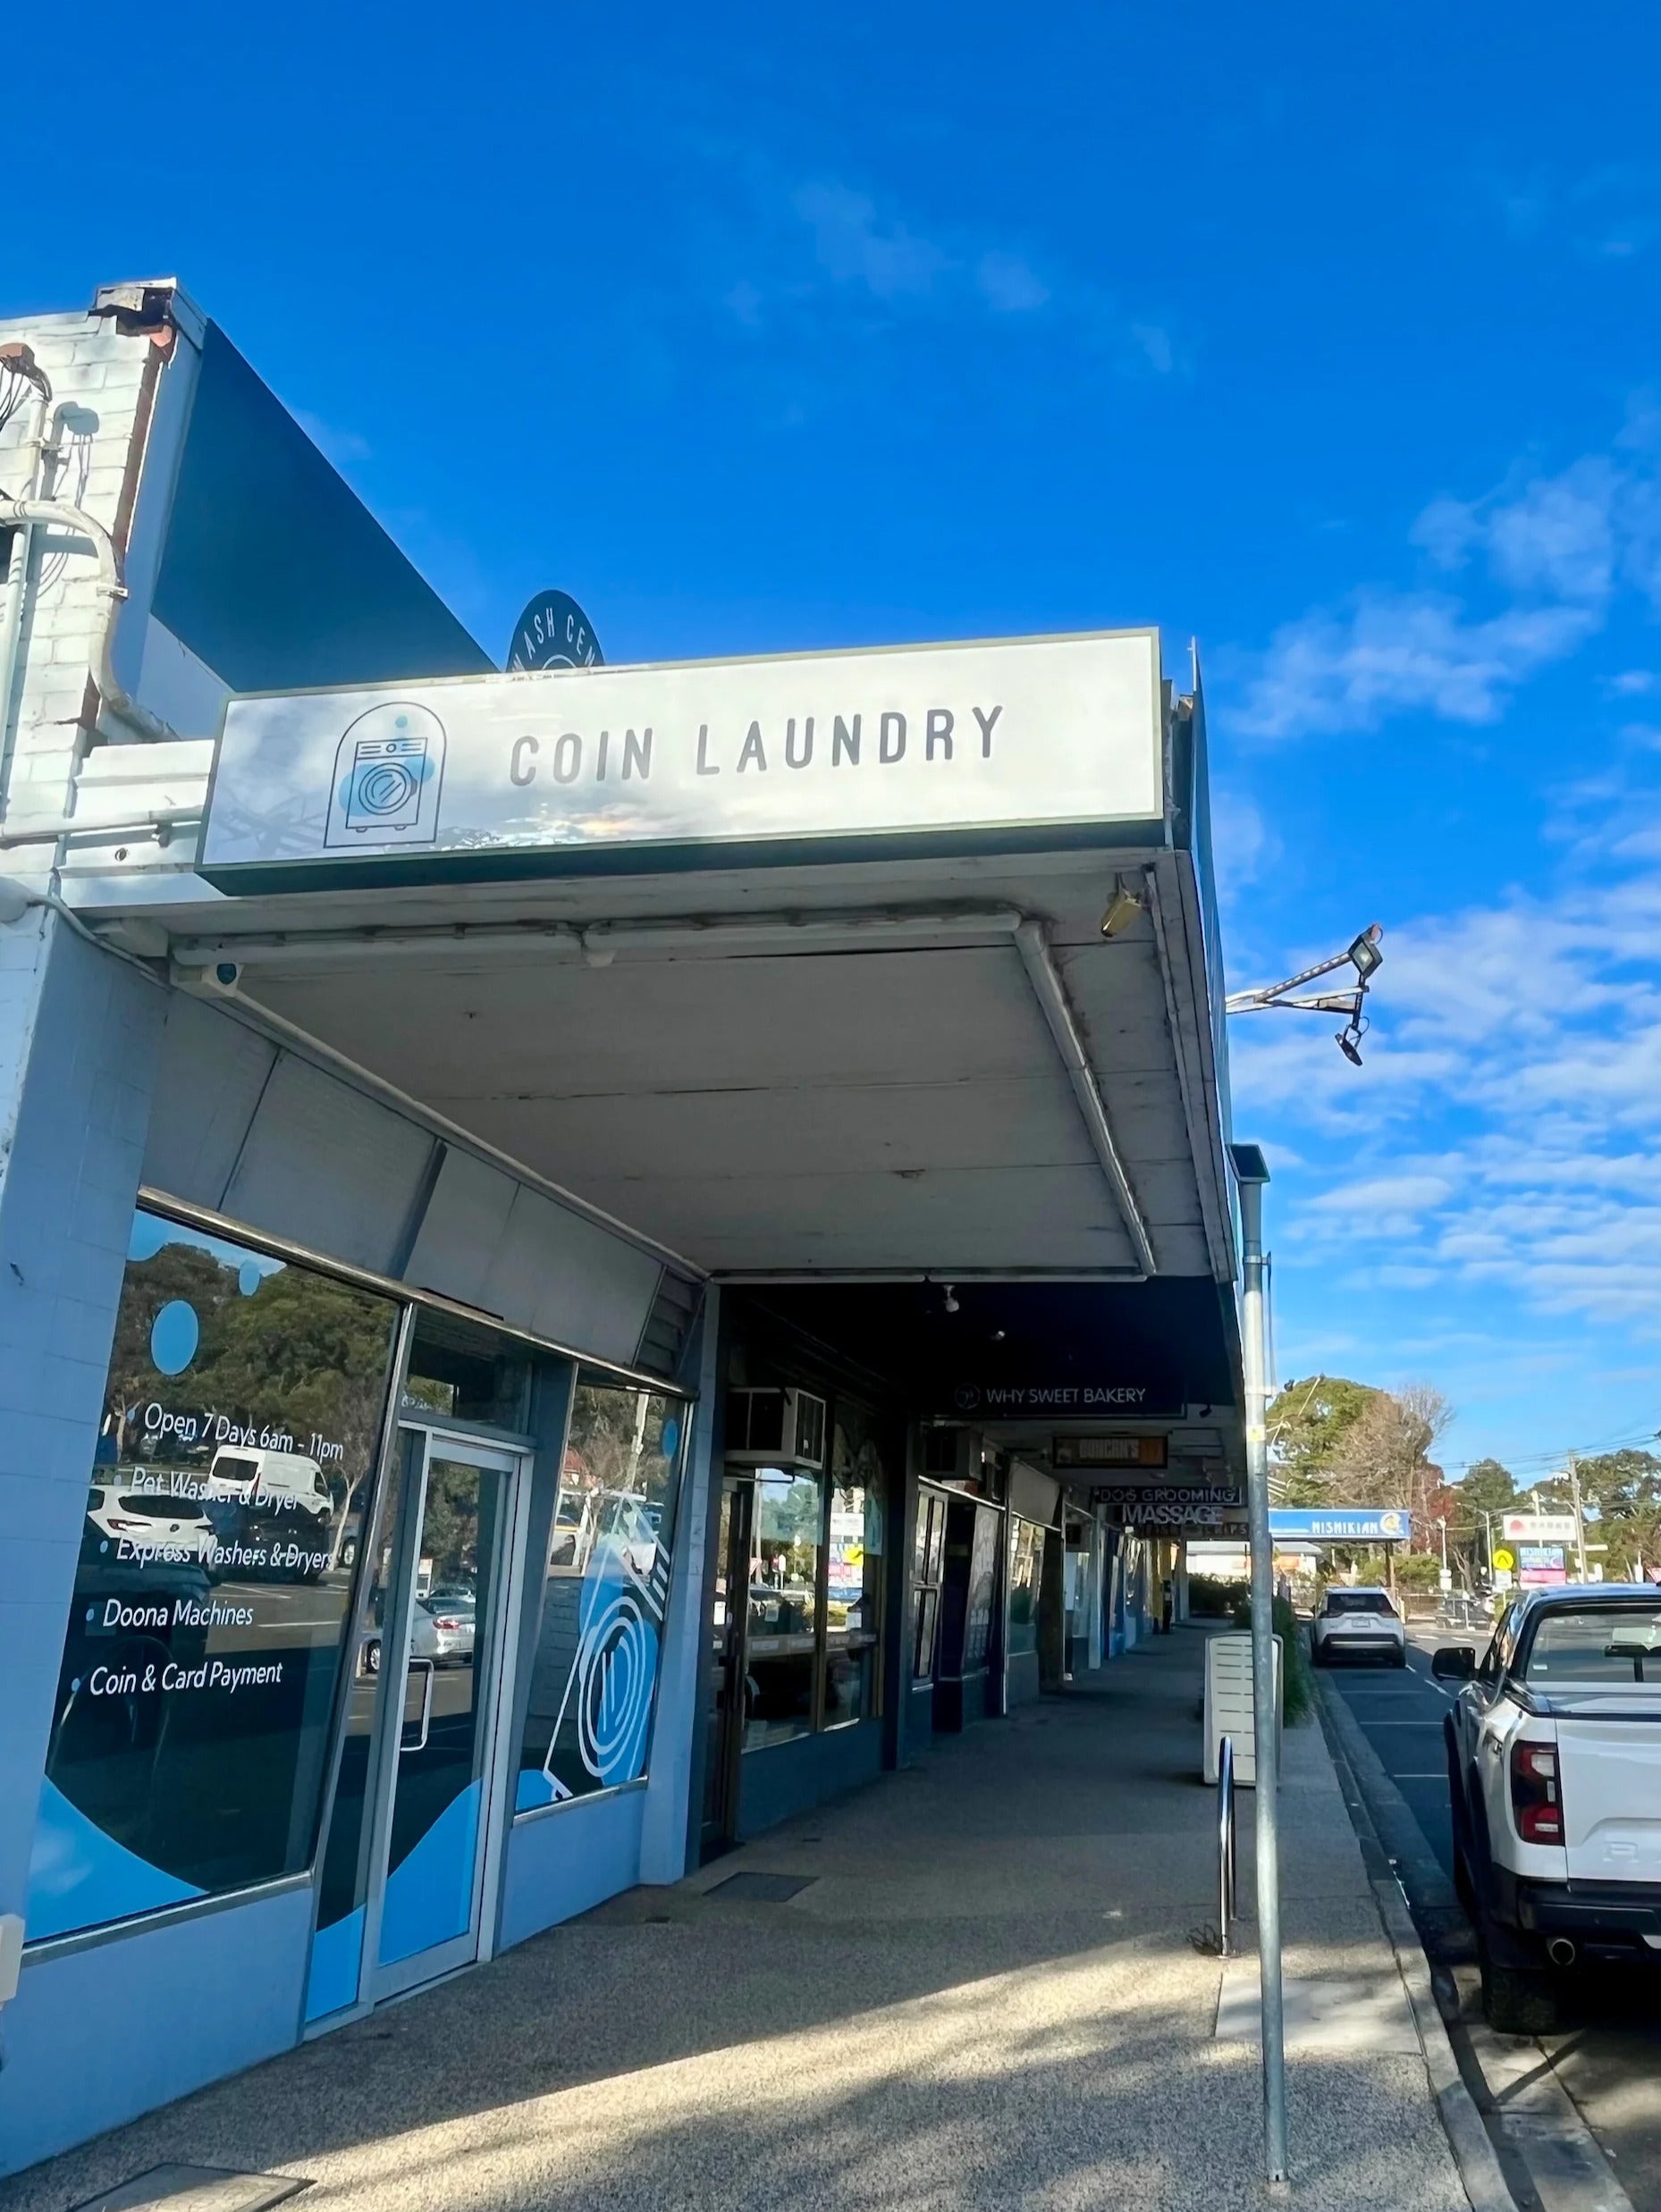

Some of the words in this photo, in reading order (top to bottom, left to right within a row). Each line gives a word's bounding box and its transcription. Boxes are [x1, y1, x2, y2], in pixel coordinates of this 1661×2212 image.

[510, 727, 653, 786] COIN
[696, 704, 1004, 776] LAUNDRY
[986, 1389, 1025, 1403] WHY
[1029, 1388, 1079, 1403] SWEET
[1083, 1387, 1146, 1403] BAKERY
[144, 1402, 198, 1439] Open
[200, 1412, 215, 1438] 7
[215, 1414, 257, 1449] Days
[259, 1425, 294, 1452] 6am
[309, 1432, 344, 1465] 11pm
[130, 1465, 164, 1496] Pet
[255, 1489, 299, 1517] Dryer
[1100, 1487, 1138, 1502] DOG
[1142, 1487, 1236, 1502] GROOMING
[1122, 1504, 1224, 1525] MASSAGE
[115, 1535, 192, 1569] Express
[197, 1537, 266, 1566] Washers
[269, 1541, 285, 1567] &
[284, 1543, 334, 1576] Dryers
[103, 1598, 169, 1627] Doona
[172, 1599, 254, 1627] Machines
[89, 1665, 137, 1695] Coin
[141, 1663, 157, 1692] &
[161, 1661, 208, 1691] Card
[208, 1661, 283, 1694] Payment
